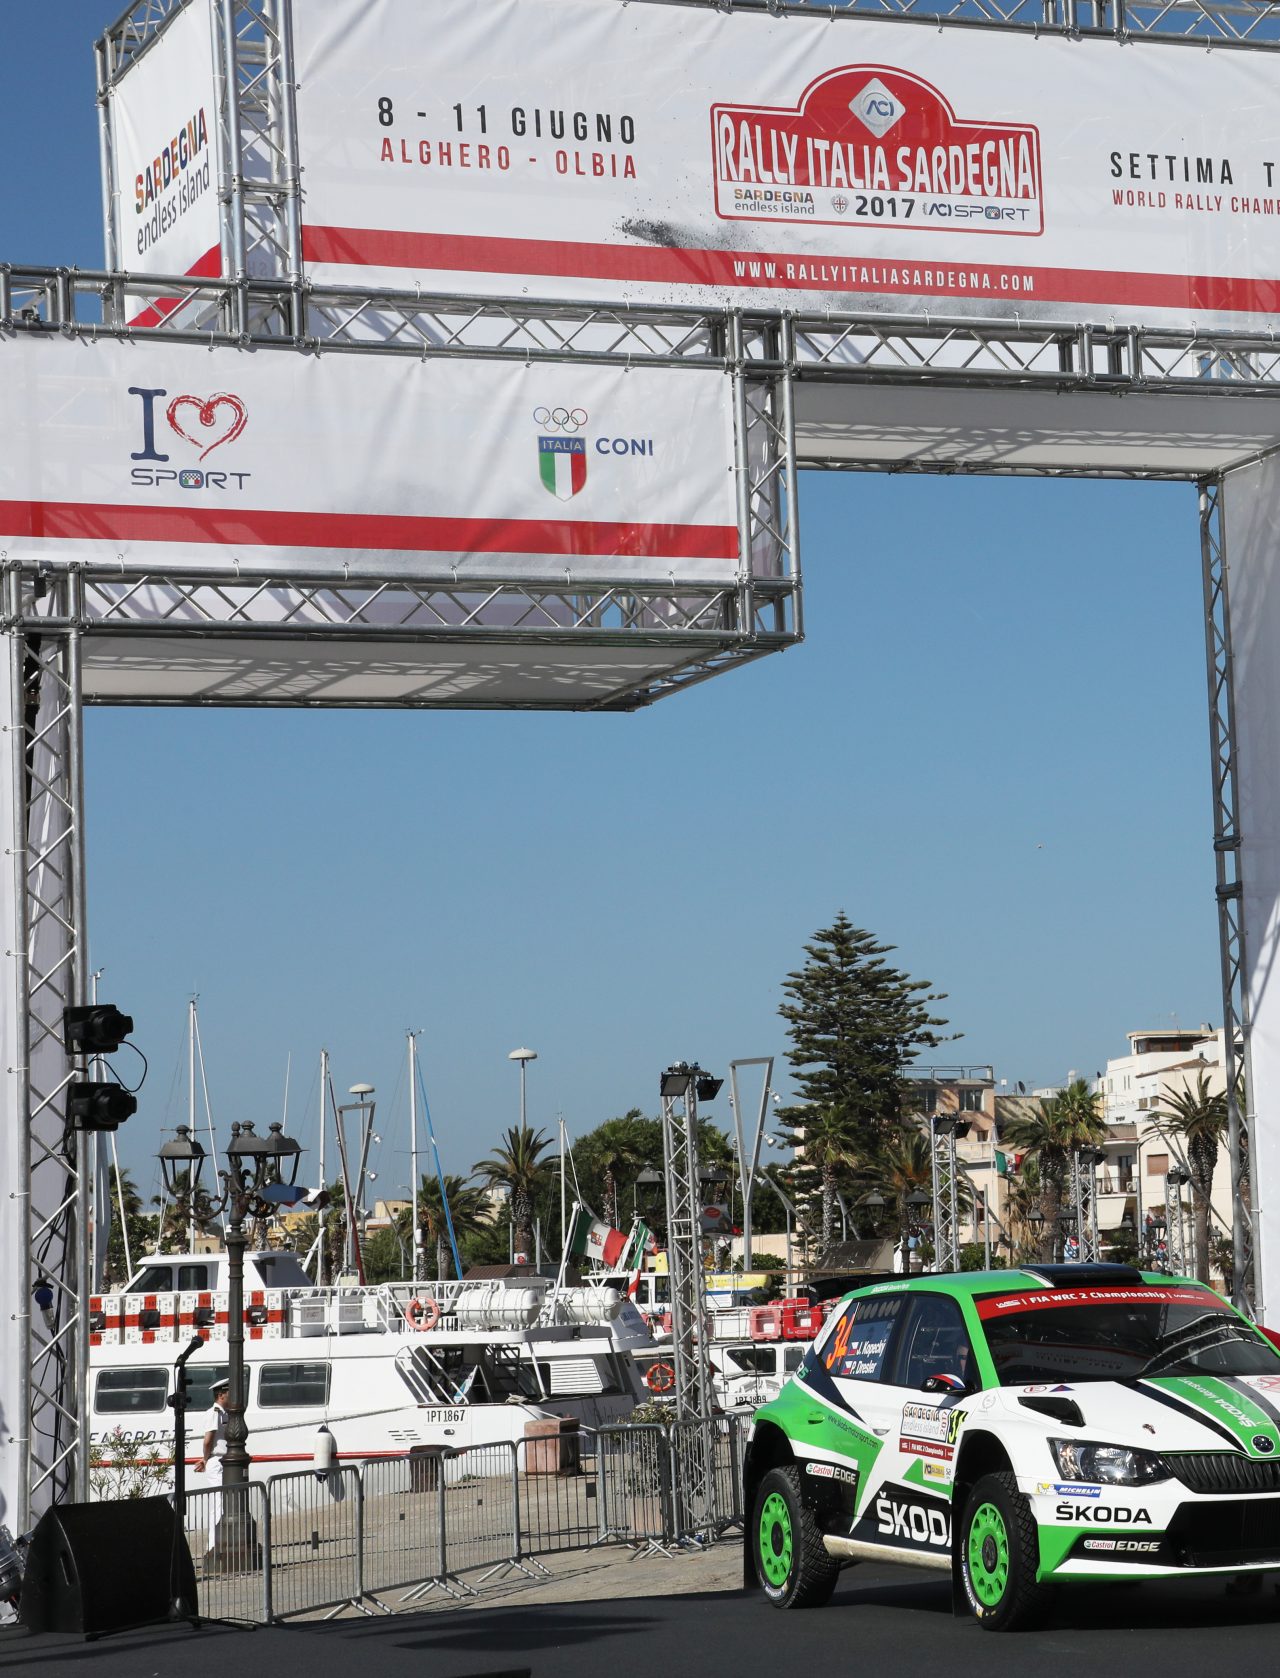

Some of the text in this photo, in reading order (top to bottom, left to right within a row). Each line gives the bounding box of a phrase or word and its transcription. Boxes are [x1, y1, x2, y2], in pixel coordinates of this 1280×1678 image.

[866, 99, 896, 117] ACI
[377, 96, 395, 127] 8
[452, 102, 487, 136] 11
[511, 105, 636, 145] GIUGNO
[135, 107, 208, 214] SARDEGNA
[380, 137, 512, 171] ALGHERO
[555, 150, 638, 179] OLBIA
[719, 113, 1036, 199] RALLY ITALIA SARDEGNA
[1110, 151, 1234, 185] SETTIMA
[136, 159, 210, 255] endless island
[734, 188, 815, 204] SARDEGNA
[734, 201, 815, 215] endless island
[855, 195, 916, 219] 2017
[1112, 189, 1168, 209] WORLD
[1175, 192, 1223, 213] RALLY
[734, 260, 1035, 292] WWW.RALLYITALIASARDEGNA.COM
[128, 387, 170, 462] I
[542, 438, 583, 453] ITALIA
[595, 437, 654, 456] CONI
[131, 468, 251, 491] SPORT
[1030, 1294, 1051, 1304] FIA
[1053, 1293, 1076, 1301] WRC
[1090, 1291, 1167, 1299] Championship
[826, 1314, 856, 1369] 34
[849, 1360, 878, 1375] P. Dresler
[904, 1406, 941, 1423] SARDEGNA
[940, 1411, 948, 1436] 2017
[812, 1464, 857, 1485] Castrol EDGE
[876, 1491, 952, 1548] ŠKOD
[1056, 1501, 1152, 1524] ŠKODA
[1091, 1541, 1161, 1552] Castrol EDGE
